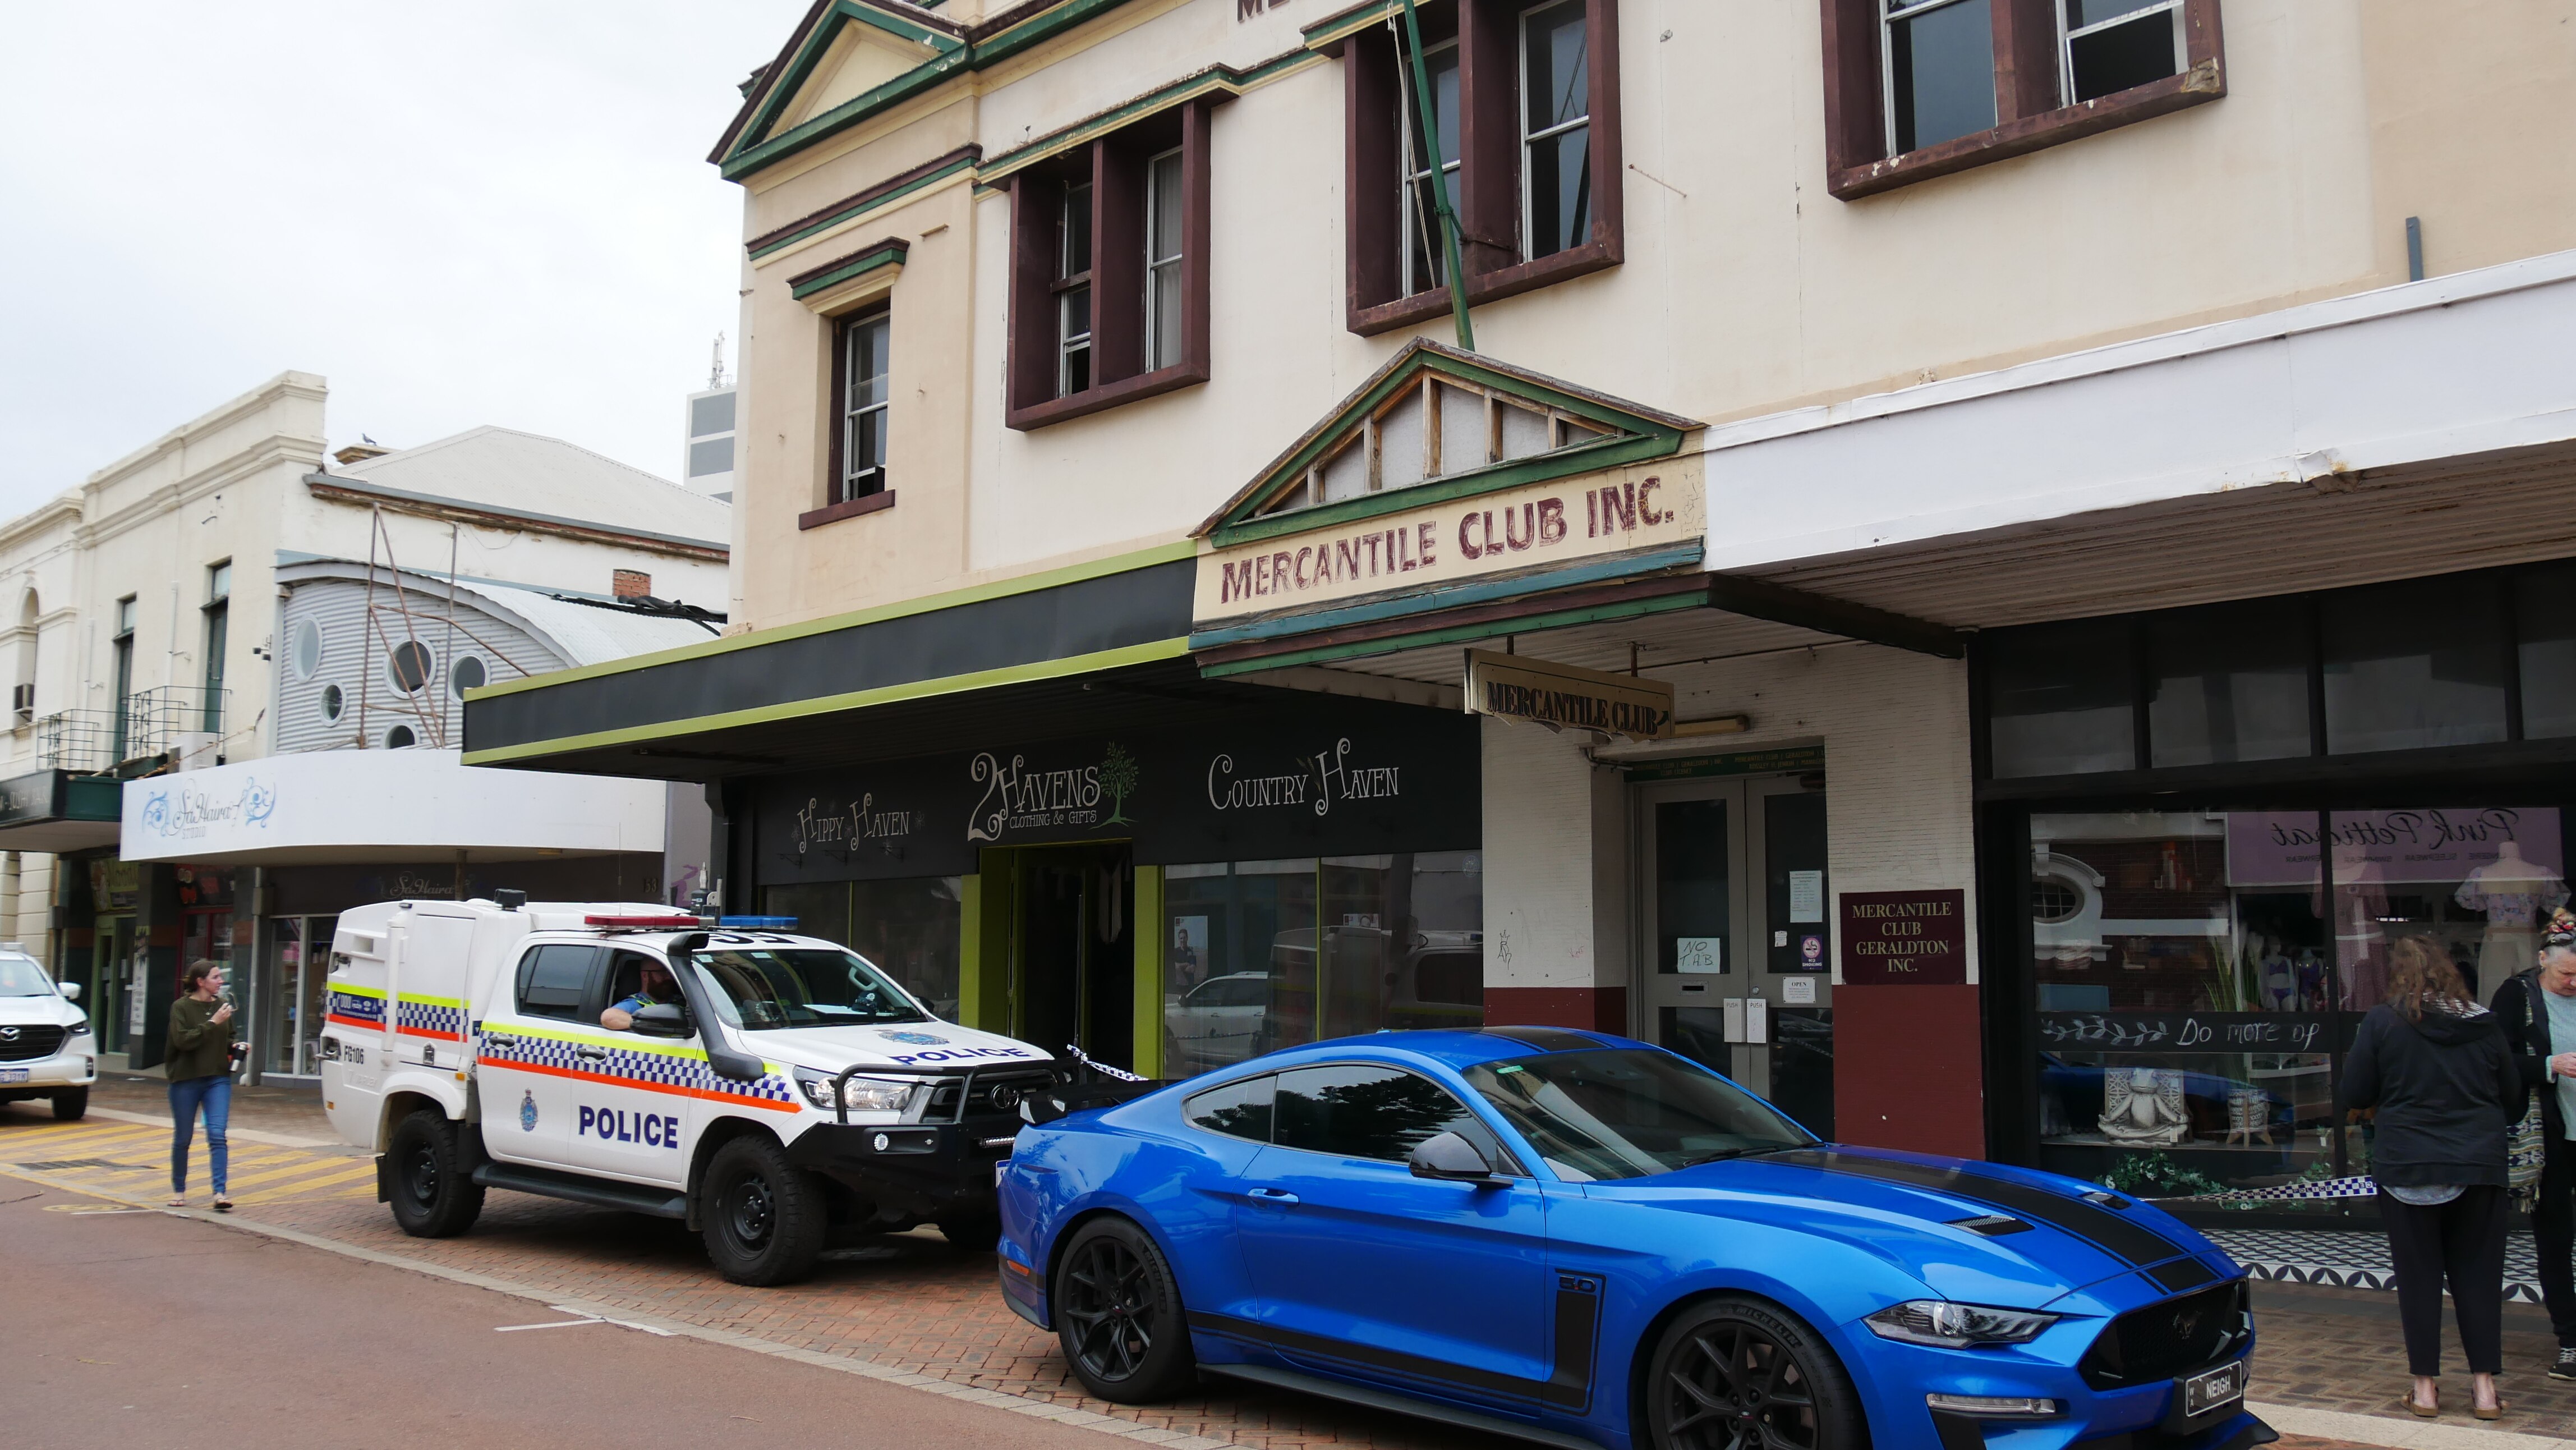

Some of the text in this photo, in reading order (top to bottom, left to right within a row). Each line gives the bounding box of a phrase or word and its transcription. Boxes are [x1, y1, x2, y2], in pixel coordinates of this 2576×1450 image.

[1221, 475, 1674, 603] MERCANTILE CLUB INC.
[1487, 681, 1658, 735] MERCANTILE CLUB
[1009, 810, 1097, 829] CLOTHING & GIFTS
[182, 826, 206, 839] STUDIO
[1852, 902, 1952, 919] MERCANTILE
[1882, 922, 1922, 936] CLUB
[1683, 941, 1708, 953] NO
[1856, 940, 1949, 955] GERALDTON
[1887, 958, 1918, 972] INC.
[2175, 1017, 2212, 1046] Do
[2227, 1021, 2281, 1044] more
[344, 1045, 364, 1064] FG106
[887, 1047, 1032, 1065] POLICE
[578, 1105, 678, 1149] POLICE
[2293, 1185, 2332, 1194] POLICE
[1560, 1274, 1596, 1292] 5.0
[1736, 1306, 1803, 1348] MICHELIN
[2206, 1374, 2231, 1400] NEIGH
